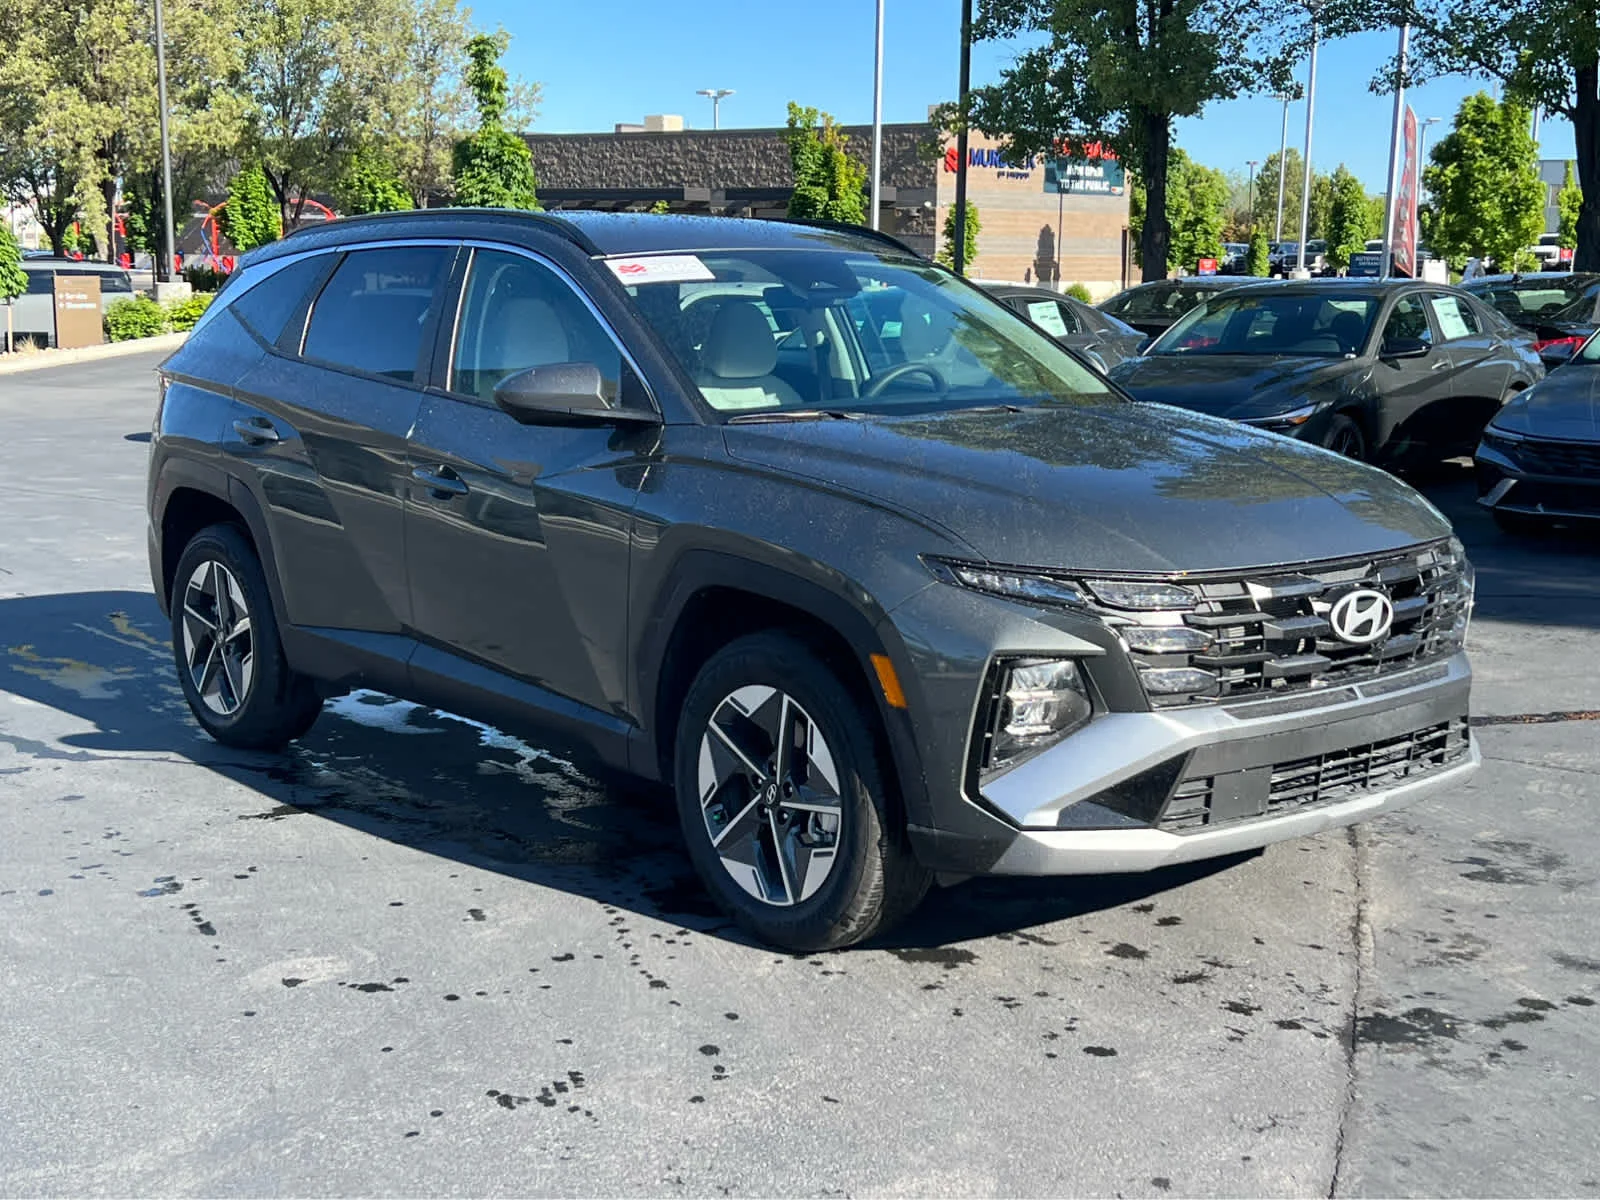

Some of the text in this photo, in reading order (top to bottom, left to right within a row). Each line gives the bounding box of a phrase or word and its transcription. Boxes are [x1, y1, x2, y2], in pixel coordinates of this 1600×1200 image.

[1085, 165, 1104, 177] OPEN
[1060, 179, 1070, 189] TO
[1071, 180, 1084, 191] THE
[1085, 180, 1110, 192] PUBLIC
